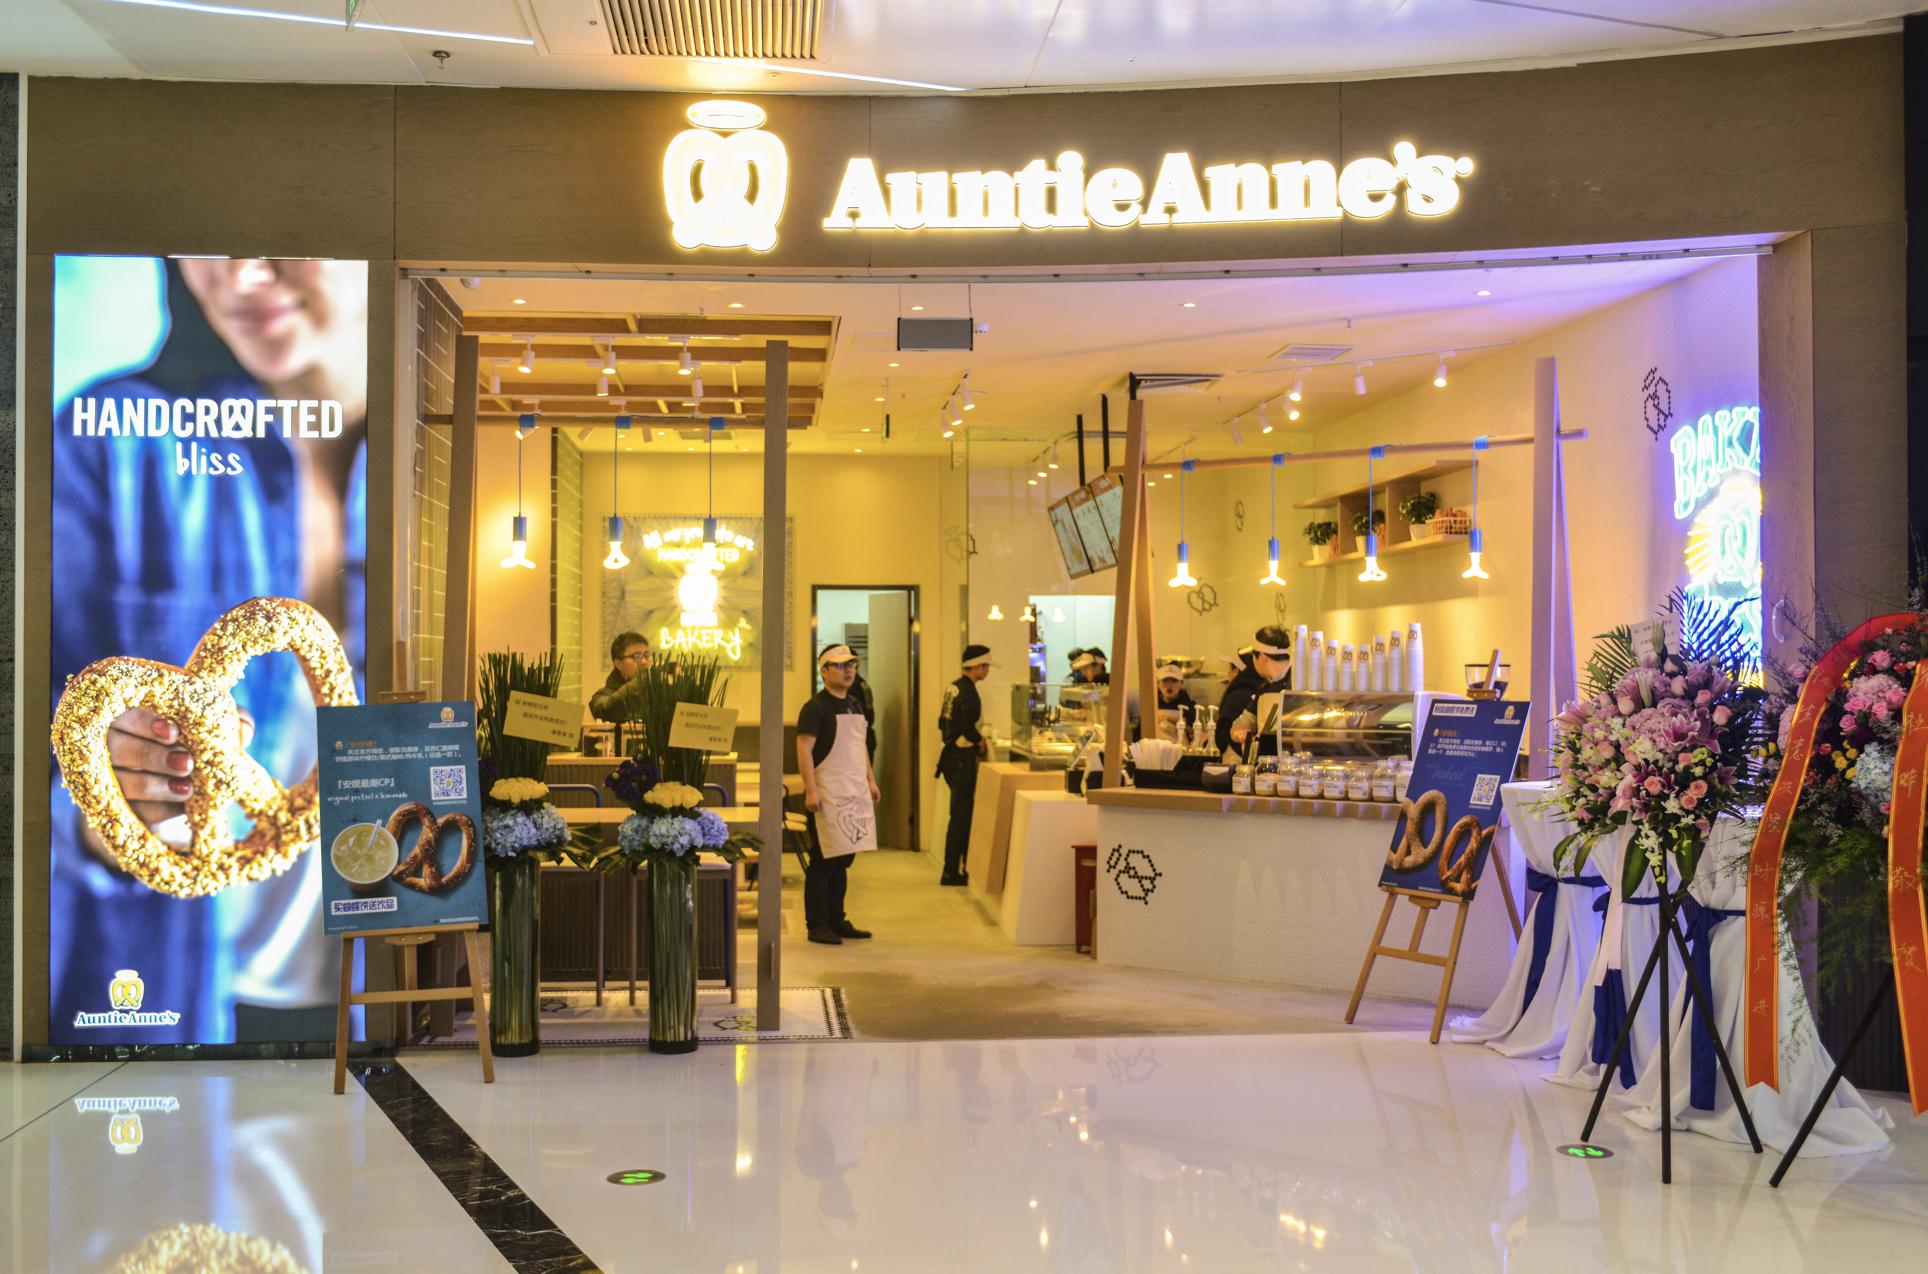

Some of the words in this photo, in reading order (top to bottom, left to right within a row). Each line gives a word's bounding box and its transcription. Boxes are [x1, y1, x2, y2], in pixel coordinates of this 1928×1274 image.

[176, 441, 243, 475] bliss
[1670, 407, 1760, 519] BAK
[660, 627, 743, 661] BAKERY
[74, 1010, 181, 1029] AuntieAnne's
